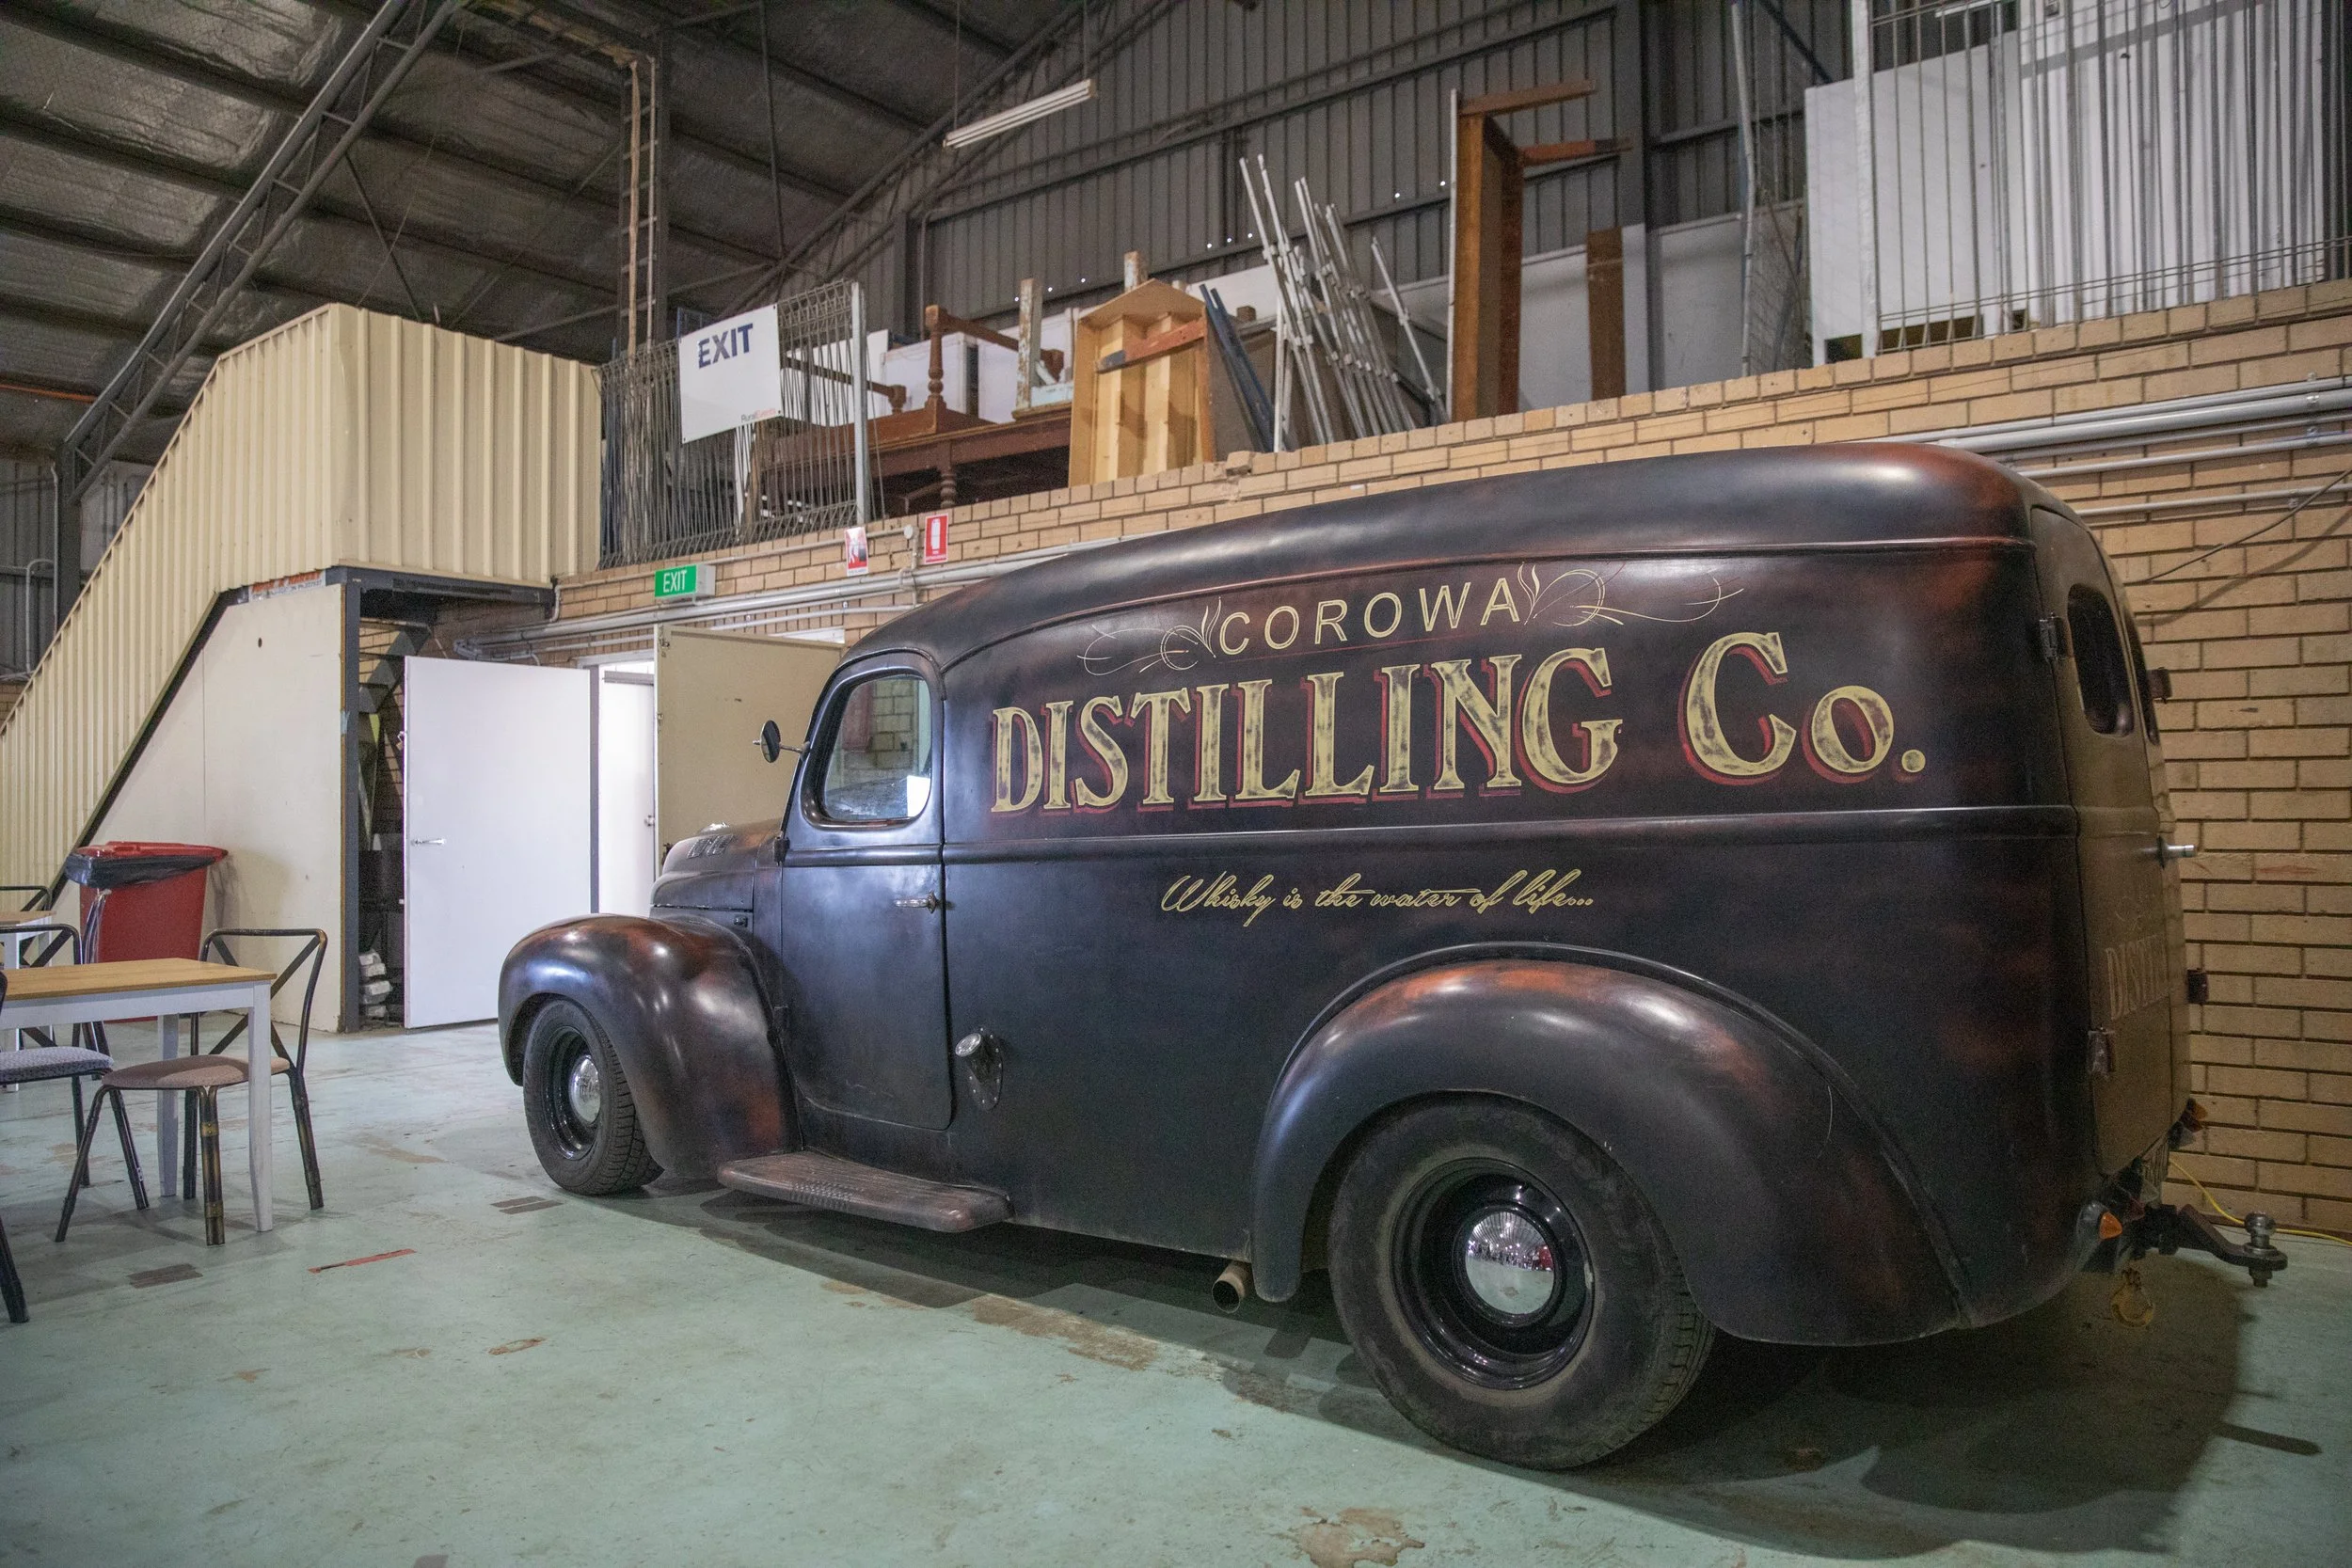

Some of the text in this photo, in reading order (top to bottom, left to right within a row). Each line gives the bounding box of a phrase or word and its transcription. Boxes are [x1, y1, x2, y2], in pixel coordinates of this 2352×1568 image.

[698, 323, 753, 369] EXIT
[663, 570, 687, 593] EXIT
[1220, 578, 1519, 656] COROWA
[991, 631, 1926, 816] DISTILLING Co.
[1161, 868, 1594, 927] Whisky is the water of life...
